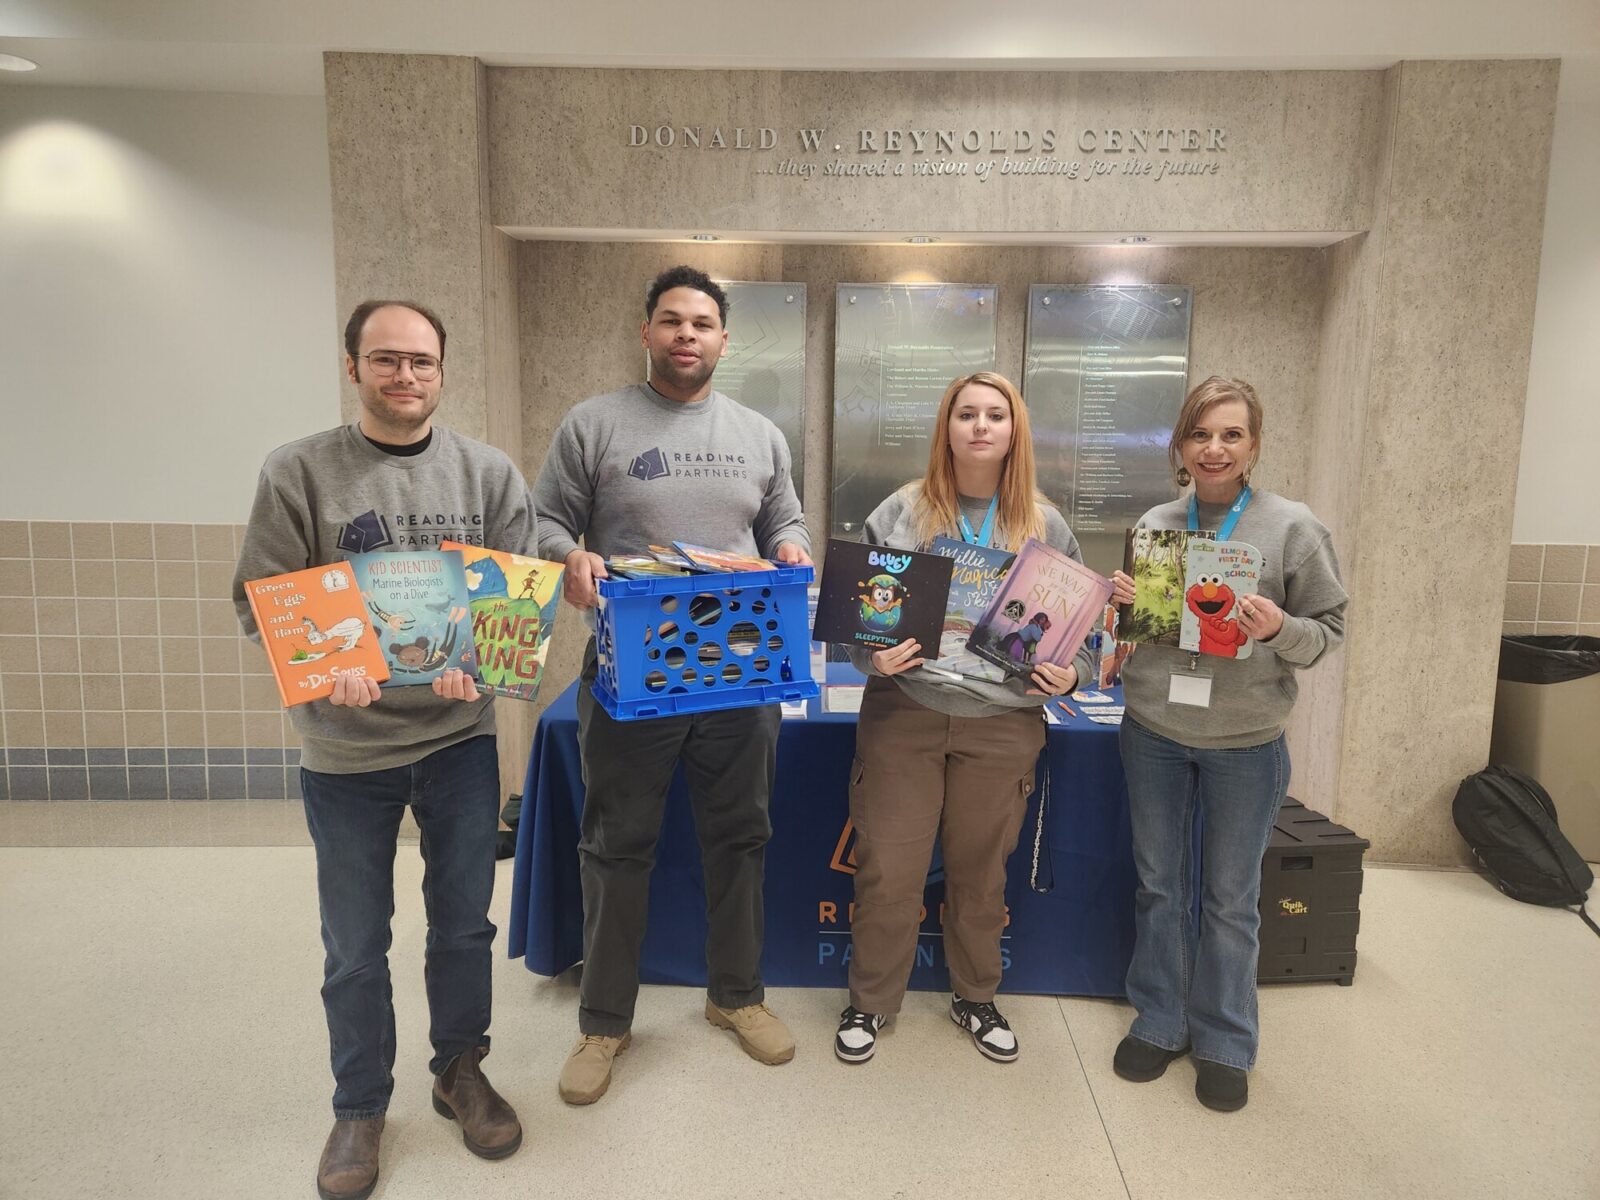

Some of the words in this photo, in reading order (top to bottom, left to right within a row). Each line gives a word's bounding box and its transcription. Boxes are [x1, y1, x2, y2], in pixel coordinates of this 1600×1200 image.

[628, 125, 779, 151] DONALD
[799, 128, 841, 153] W.
[857, 128, 1057, 154] REYNOLDS
[1077, 128, 1227, 154] CENTER
[824, 159, 887, 176] shared
[893, 163, 905, 176] a
[911, 157, 967, 176] vision
[974, 157, 997, 182] of
[1001, 156, 1081, 180] building
[1084, 158, 1118, 182] for
[1122, 157, 1152, 176] the
[1154, 157, 1220, 181] future
[673, 453, 745, 464] READING
[675, 469, 747, 479] PARTNERS
[396, 514, 482, 526] READING
[399, 534, 483, 545] PARTNERS
[1221, 548, 1248, 556] ELMO'S
[868, 551, 912, 574] BLUEY
[1241, 557, 1255, 565] DAY
[368, 560, 387, 577] KID
[391, 559, 443, 575] SCIENTIST
[1224, 570, 1257, 578] SCHOOL
[256, 580, 295, 595] Green
[373, 578, 403, 590] Marine
[405, 576, 444, 589] Biologists
[1038, 564, 1058, 580] WE
[1060, 572, 1089, 599] WAIT
[274, 594, 306, 608] Eggs
[390, 592, 403, 601] on
[404, 592, 410, 600] a
[411, 588, 430, 600] Dive
[494, 601, 509, 613] the
[1029, 583, 1077, 620] SUN
[270, 611, 294, 625] and
[275, 627, 305, 640] Ham
[472, 610, 540, 649] KING
[854, 632, 899, 645] SLEEPYTIME
[307, 674, 331, 690] Dr.
[330, 666, 366, 681] Seuss
[1283, 901, 1304, 909] Quik
